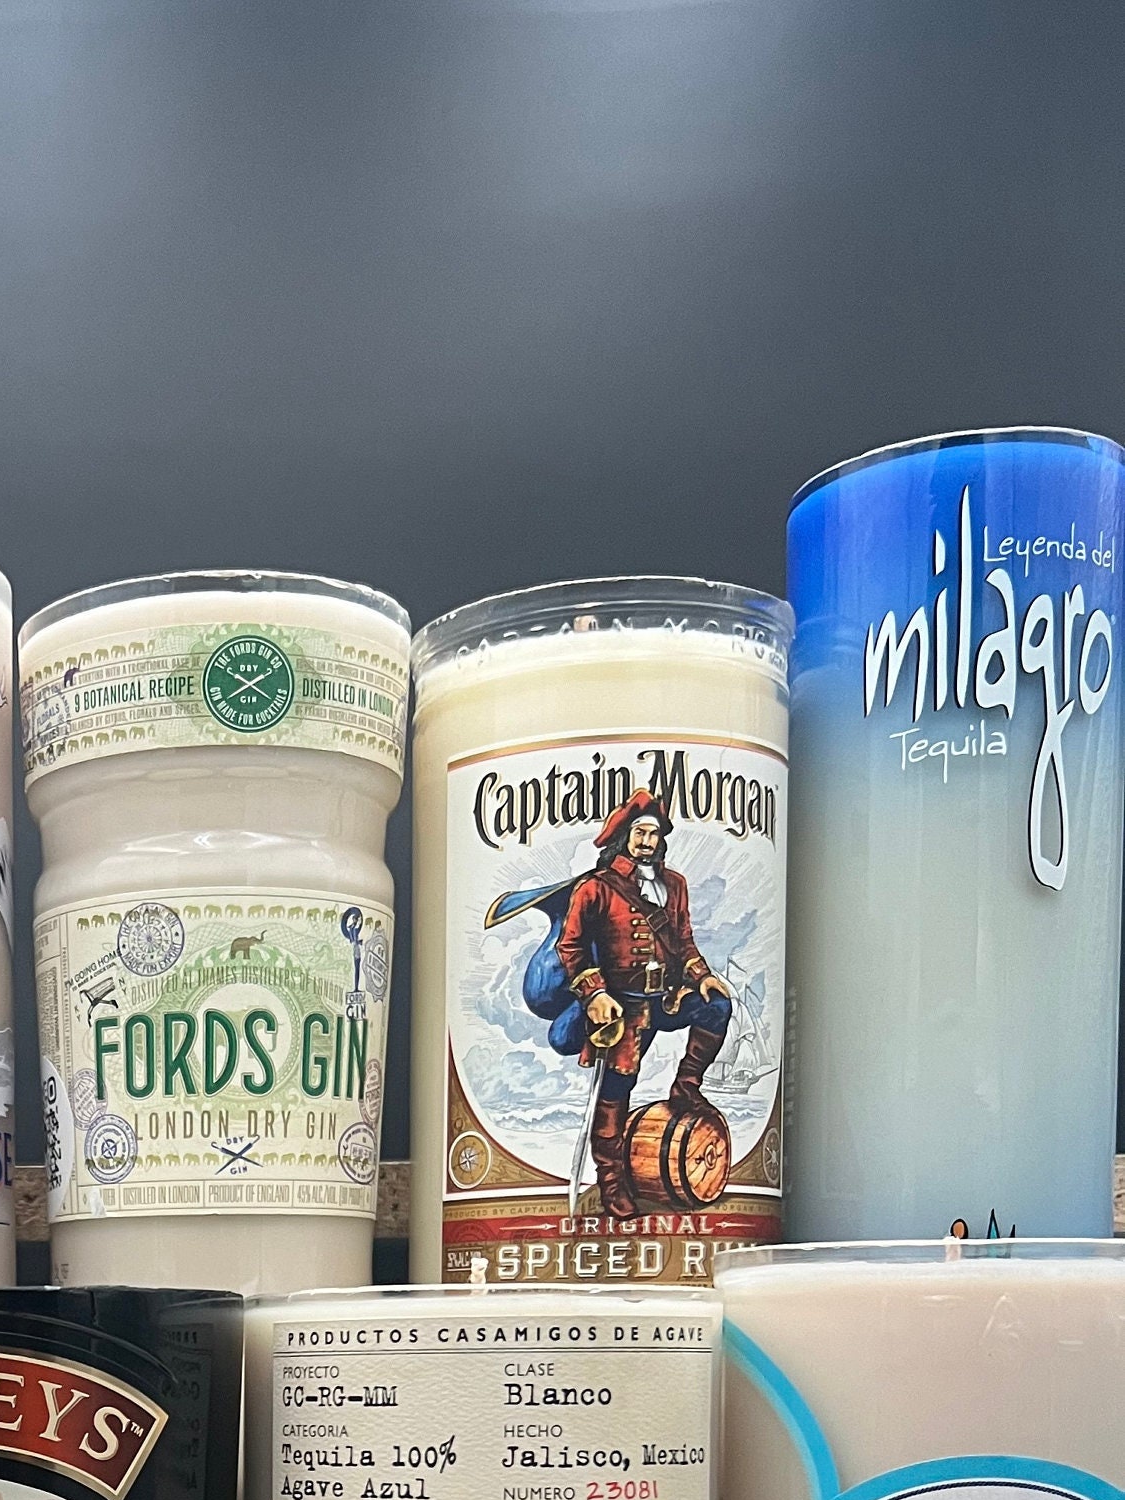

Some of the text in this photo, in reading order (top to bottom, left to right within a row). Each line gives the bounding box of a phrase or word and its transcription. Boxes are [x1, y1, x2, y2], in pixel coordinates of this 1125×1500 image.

[984, 522, 1115, 576] Leyenda del
[84, 676, 194, 711] BOTANICAL RECIPE
[303, 678, 355, 704] DISTILLED
[865, 486, 1112, 891] milagro
[256, 689, 287, 724] COCKTAILS
[890, 720, 1007, 783] Tequila
[473, 750, 777, 852] Captain Morgan
[74, 962, 97, 982] GOING
[198, 966, 295, 989] THAMES DISTILLERS
[94, 1010, 277, 1100] FORDS
[302, 1013, 368, 1100] GIN
[135, 1111, 337, 1141] LONDON DRY GIN
[510, 1206, 557, 1214] CAPTAIN
[557, 1214, 715, 1235] ORIGINAL
[497, 1241, 665, 1280] SPICED
[287, 1327, 704, 1346] PRODUCTOS CASAMIGOS DE AGAVE
[283, 1365, 340, 1379] PROYECTO
[504, 1363, 554, 1377] CLASE
[282, 1385, 398, 1407] GC-RG-MM
[504, 1383, 612, 1406] Blanco
[282, 1424, 348, 1438] CATEGORIA
[504, 1424, 563, 1438] HECHO
[281, 1435, 457, 1473] Tequila 100%
[501, 1443, 704, 1471] Jalisco, Mexico
[280, 1475, 431, 1500] Agave Azul
[503, 1480, 659, 1500] NUMERO 23081
